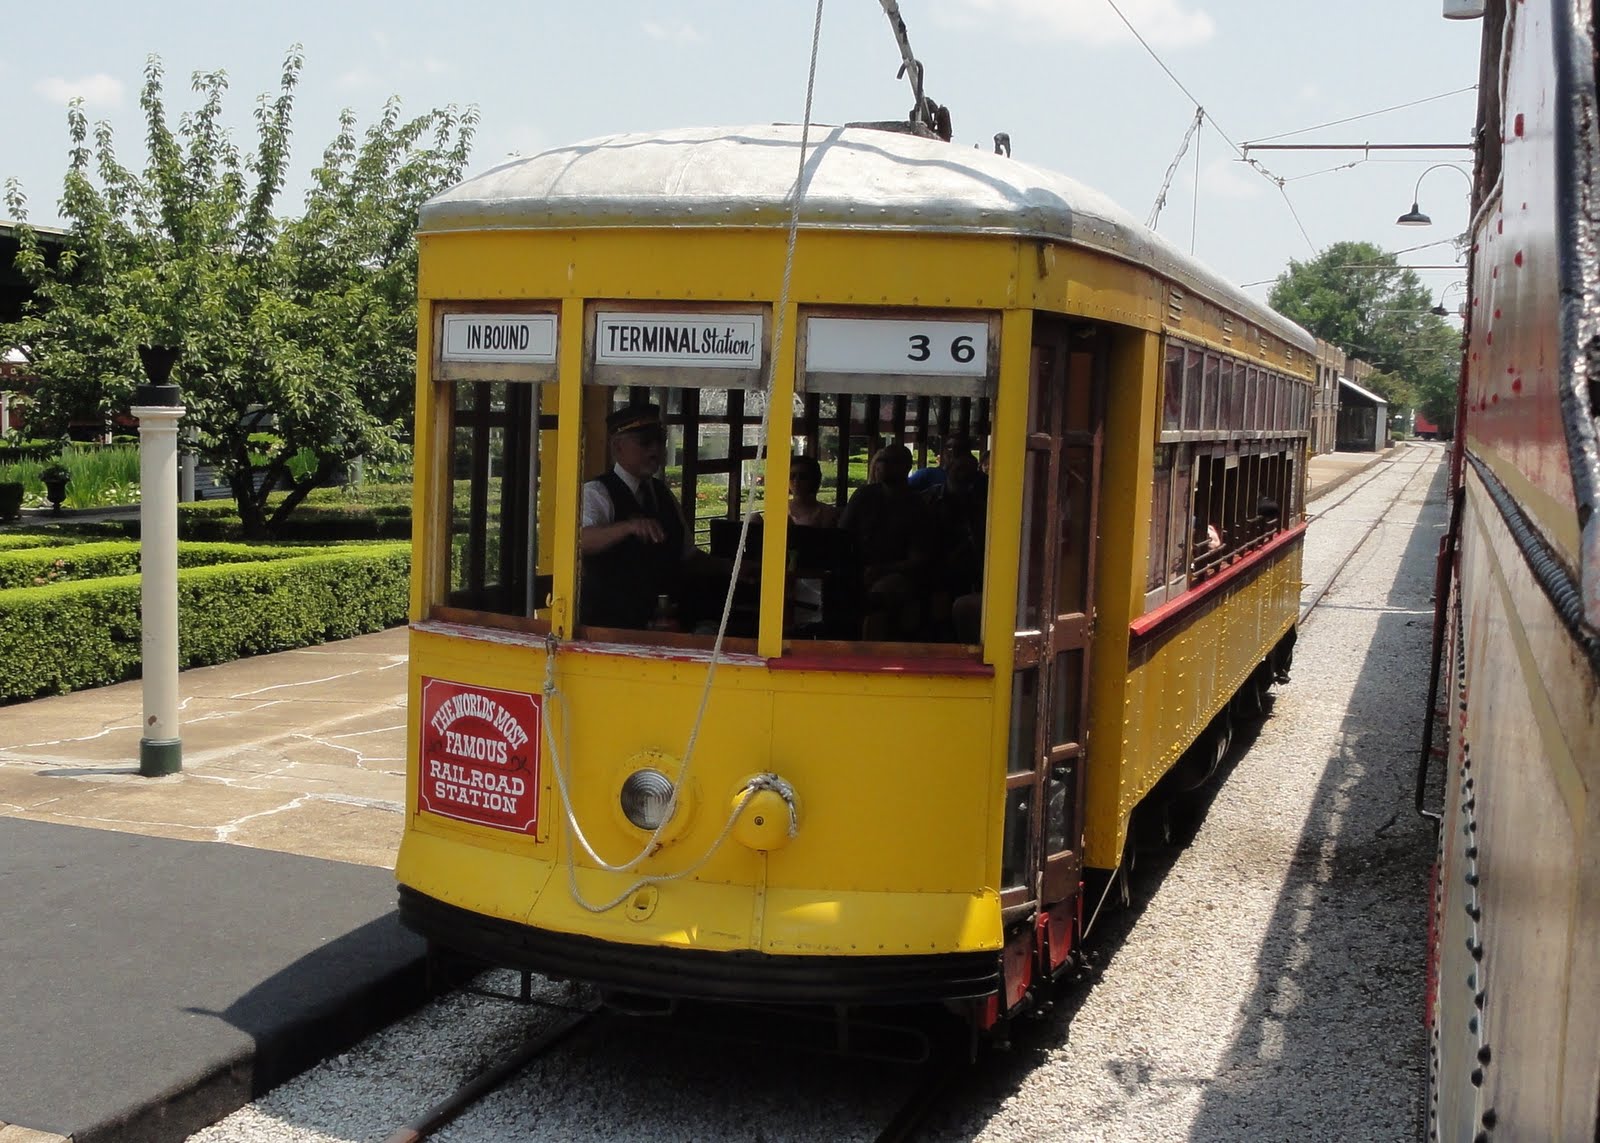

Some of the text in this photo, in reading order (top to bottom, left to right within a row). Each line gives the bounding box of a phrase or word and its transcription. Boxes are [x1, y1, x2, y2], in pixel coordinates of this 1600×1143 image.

[608, 325, 756, 355] TERMINAL Station
[430, 692, 529, 751] THE WORLDS MOST
[445, 730, 508, 765] FAMOUS
[430, 759, 525, 796] RAILROAD
[435, 781, 517, 814] STATION
